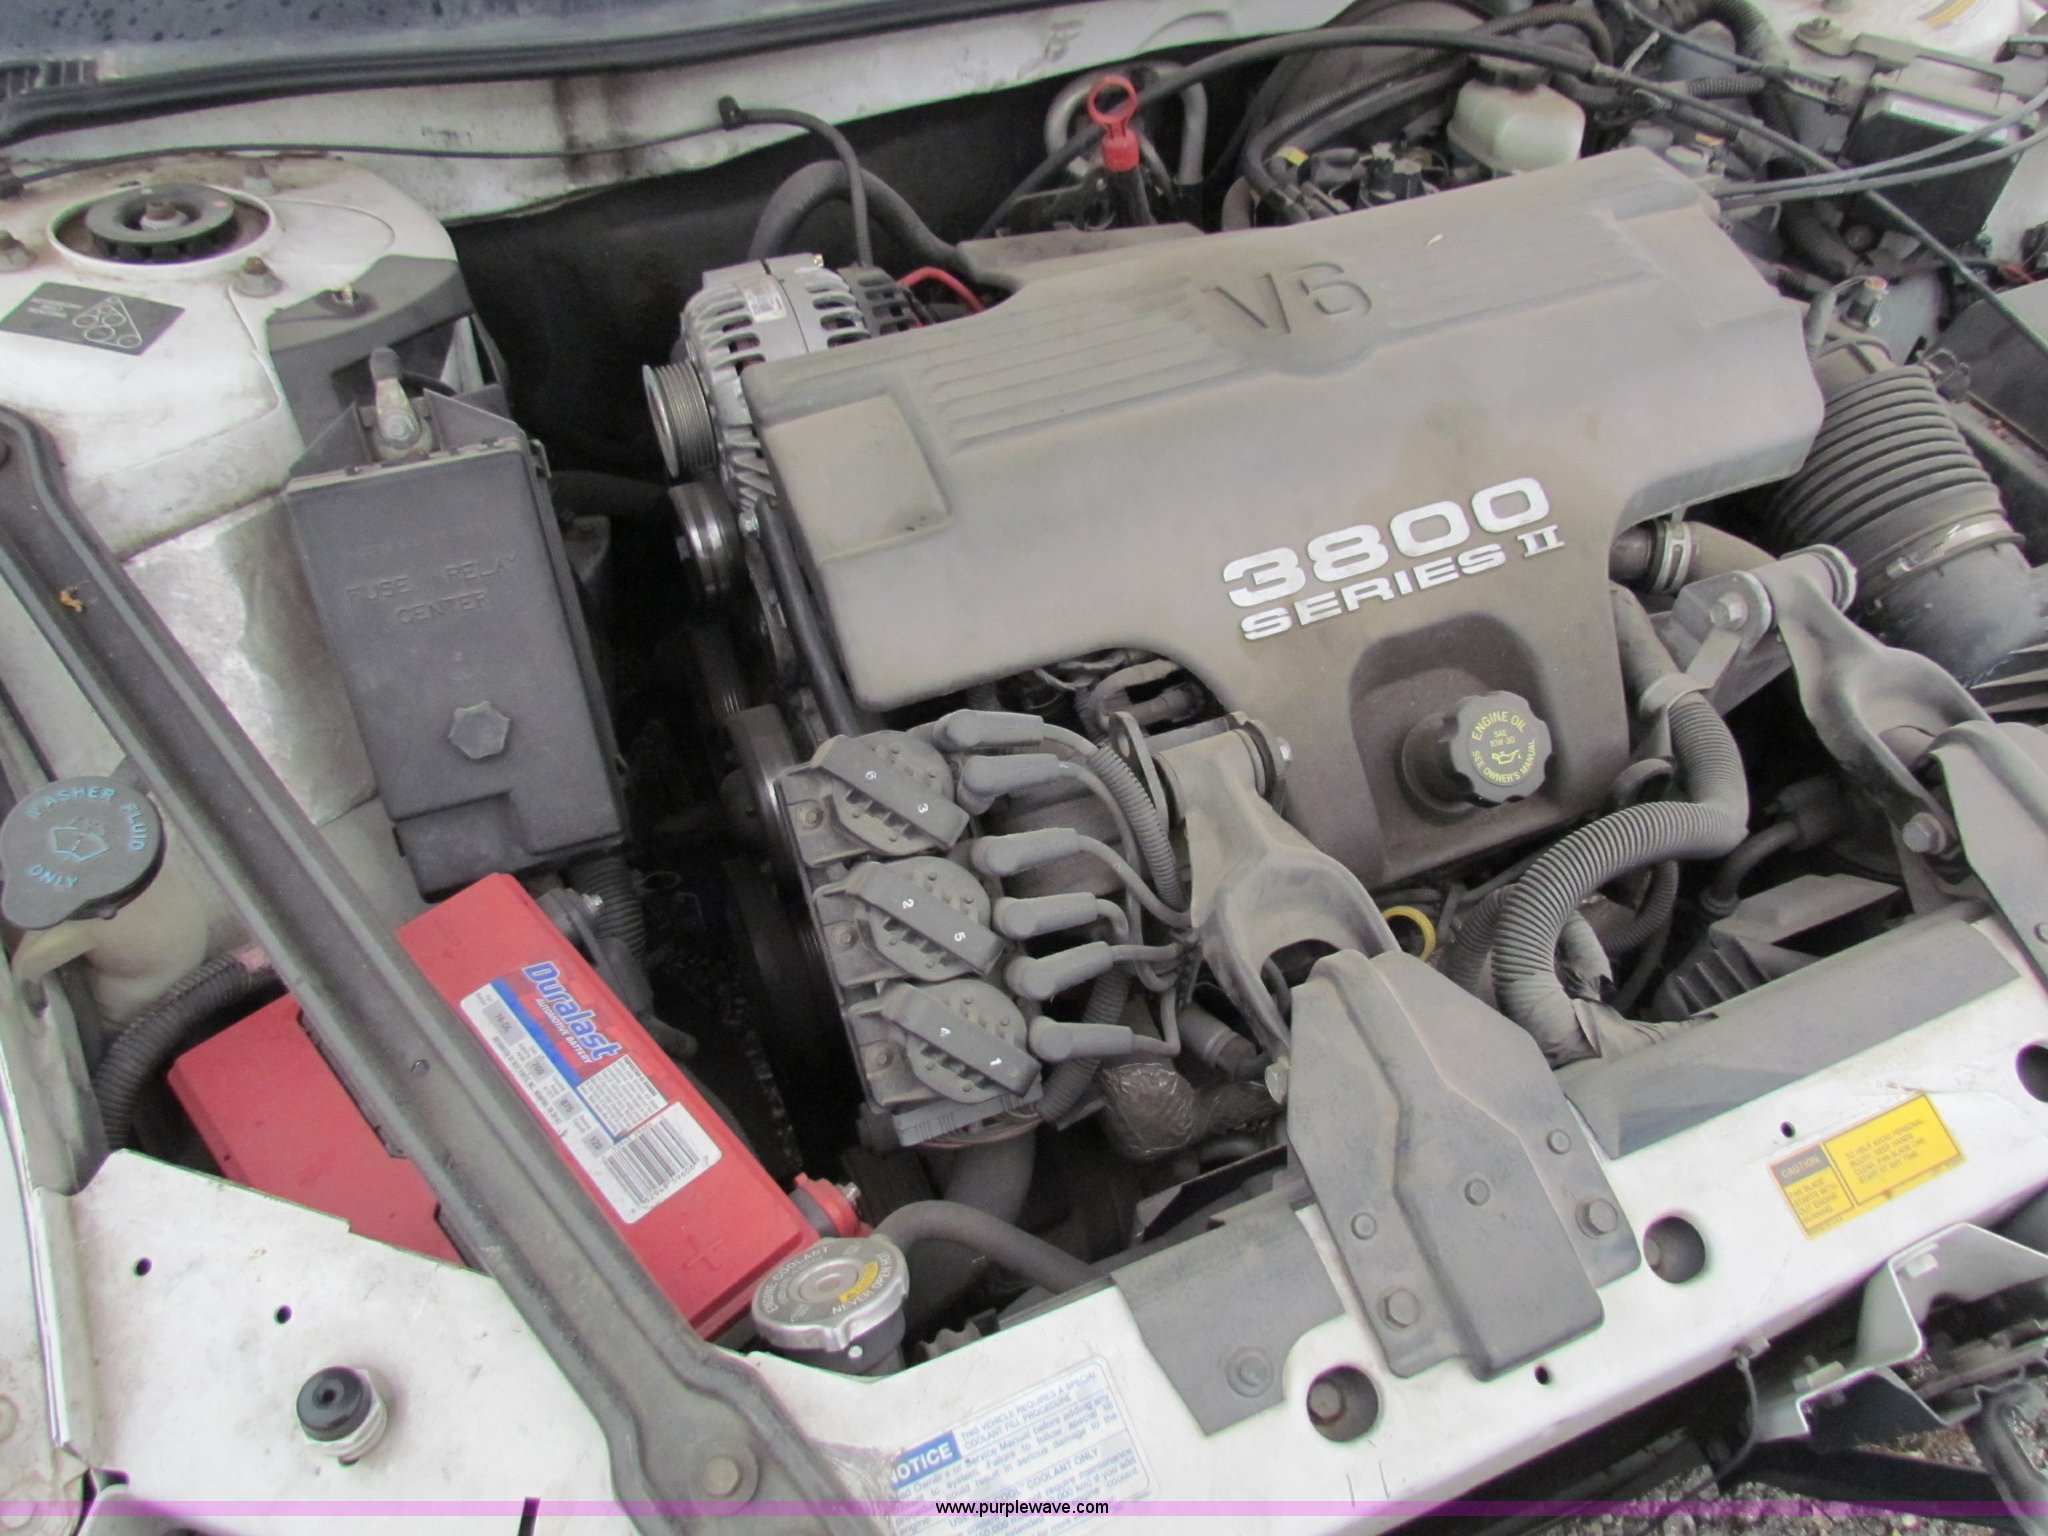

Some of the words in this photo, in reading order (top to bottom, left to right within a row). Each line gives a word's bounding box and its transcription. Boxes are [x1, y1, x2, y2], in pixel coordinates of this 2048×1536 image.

[1200, 261, 1373, 335] V6
[1222, 476, 1550, 608] 3800
[345, 575, 413, 604] FUSE
[445, 551, 518, 583] RELAY
[1240, 543, 1508, 641] SERIES
[1516, 524, 1566, 559] II
[396, 589, 492, 624] CENTER
[1471, 711, 1508, 742] ENGINE
[1510, 715, 1527, 734] OIL
[1472, 750, 1486, 769] SEE
[1482, 767, 1520, 783] OWNER'S
[1519, 738, 1537, 776] MANUAL
[26, 786, 116, 818] WASHER
[120, 803, 147, 852] FLUID
[917, 803, 929, 814] 3
[27, 864, 80, 889] ONLY
[902, 898, 915, 909] 2
[954, 931, 966, 942] 5
[521, 960, 624, 1062] Duralast
[535, 998, 571, 1039] AUTOMOTIVE
[565, 1036, 594, 1065] BATTERY
[531, 1062, 545, 1077] 700
[560, 1098, 574, 1113] 875
[589, 1135, 604, 1150] 120
[1779, 1153, 1821, 1180] CAUTION
[772, 1246, 829, 1281] COOLANT
[831, 1289, 873, 1315] NEVER
[873, 1266, 892, 1289] OPEN
[960, 1425, 981, 1441] THIS
[979, 1409, 1014, 1432] VEHICLE
[1014, 1388, 1057, 1415] REQUIRES
[1063, 1369, 1097, 1391] SPECIAL
[963, 1445, 998, 1469] Service
[997, 1429, 1031, 1452] Manual
[1032, 1415, 1062, 1436] before
[1061, 1400, 1093, 1423] adding
[963, 1425, 1004, 1451] COOLANT
[985, 1448, 1017, 1470] Failure
[1035, 1426, 1063, 1445] follow
[1051, 1426, 1088, 1452] damage
[1025, 1459, 1072, 1489] COOLANT
[1071, 1445, 1099, 1465] ONLY
